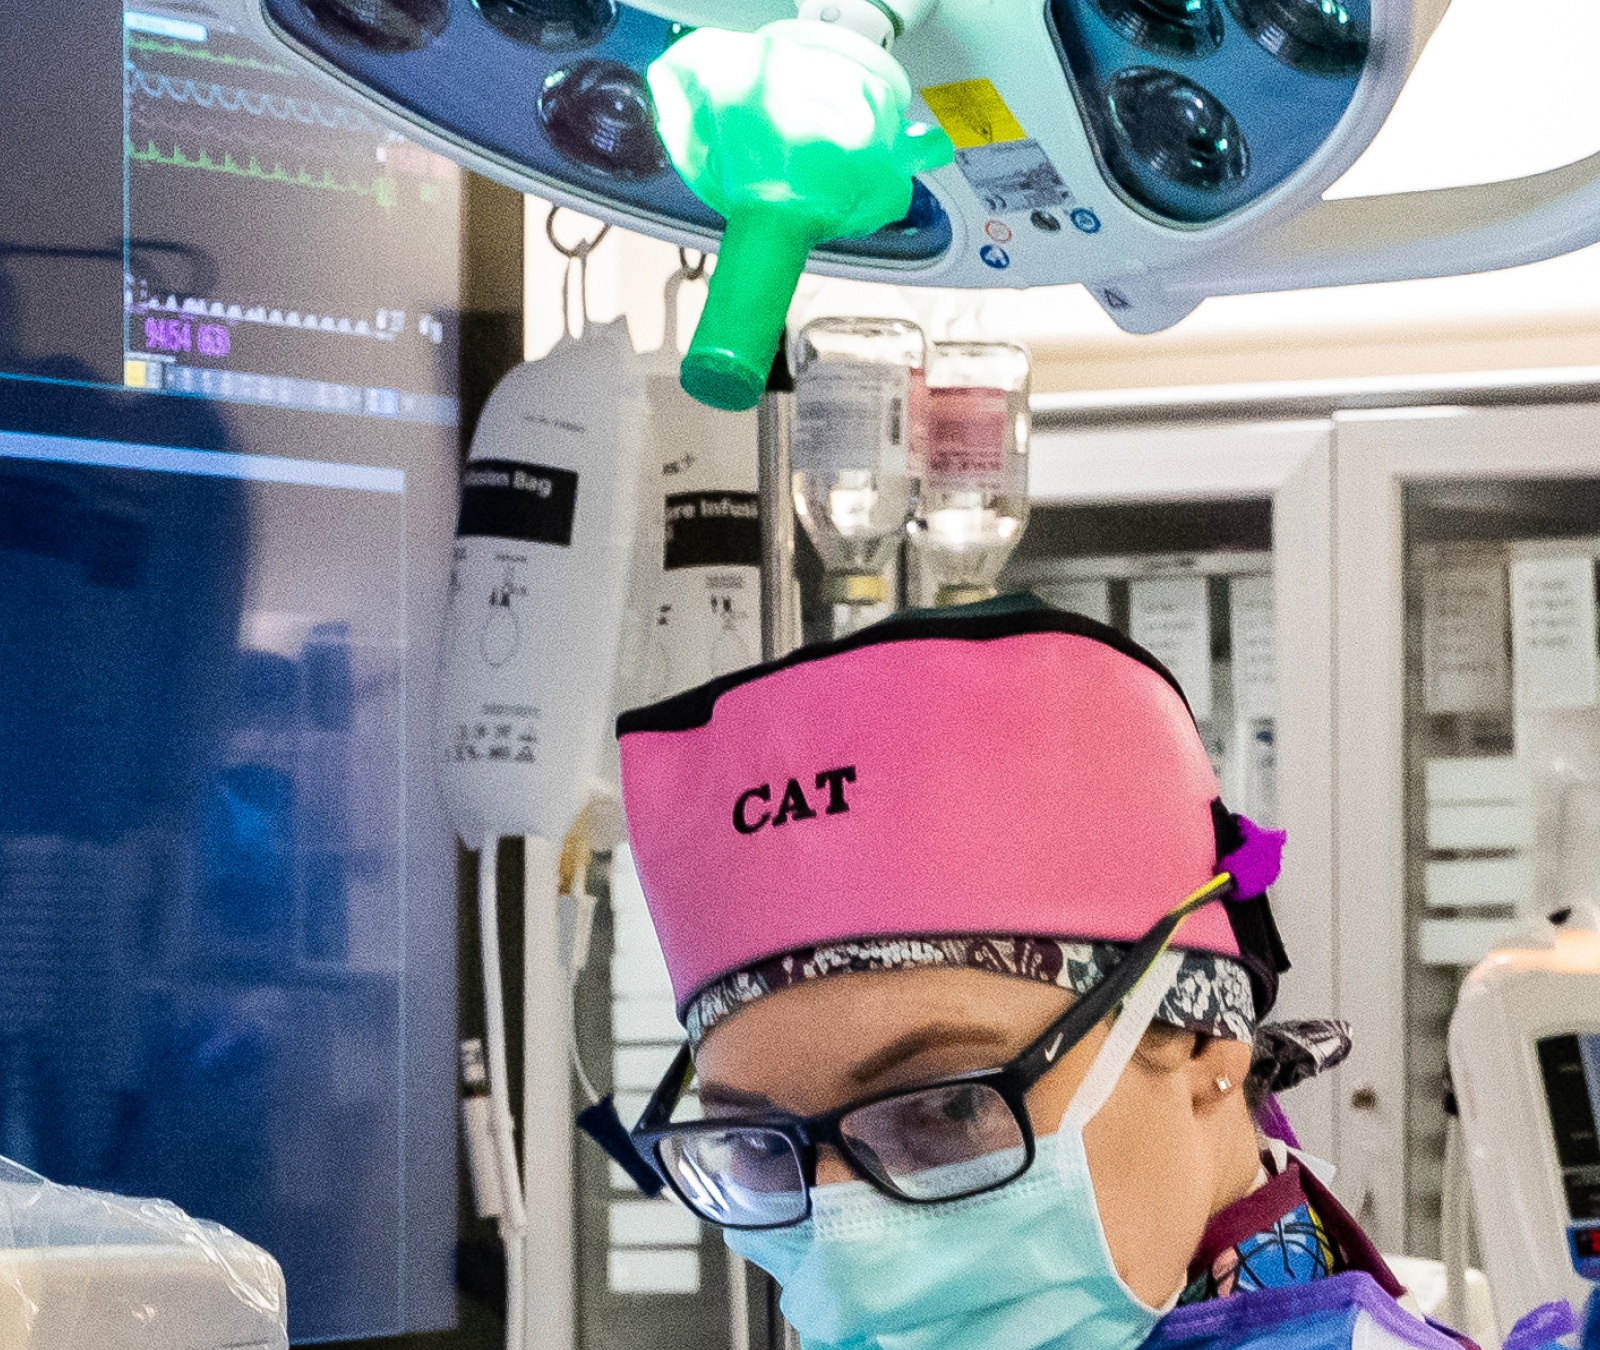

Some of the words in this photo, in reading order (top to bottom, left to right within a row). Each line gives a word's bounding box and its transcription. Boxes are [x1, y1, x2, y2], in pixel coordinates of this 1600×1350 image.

[513, 470, 552, 498] Bag
[700, 498, 759, 519] Infusi
[732, 765, 857, 835] CAT
